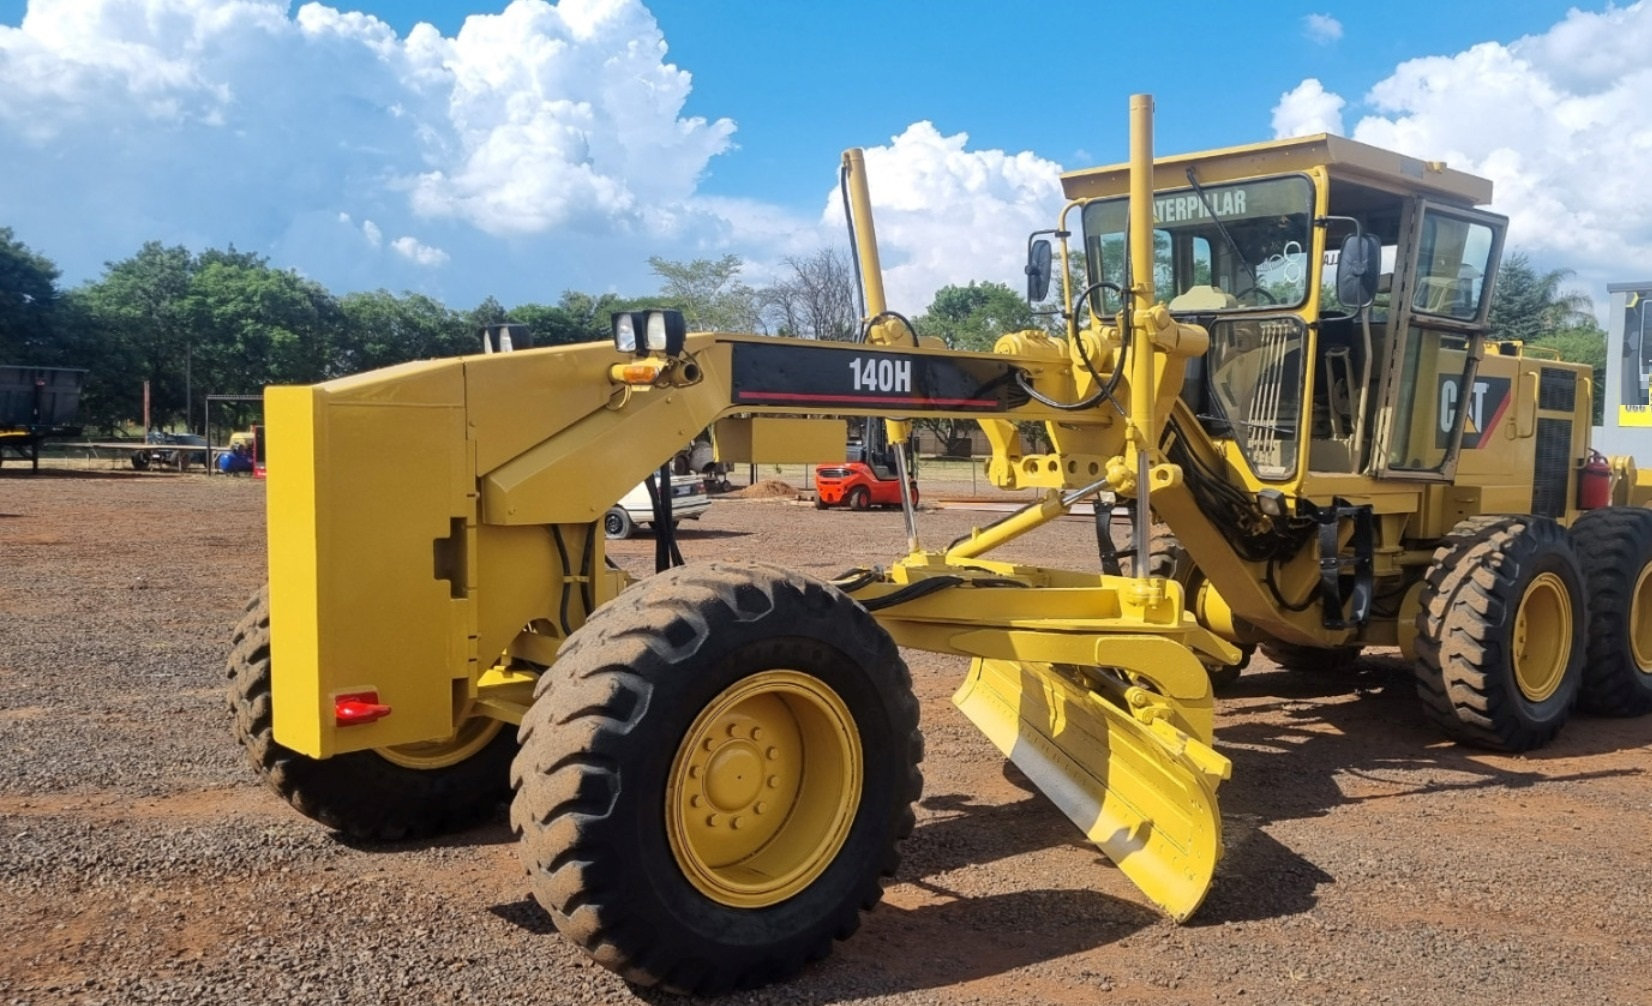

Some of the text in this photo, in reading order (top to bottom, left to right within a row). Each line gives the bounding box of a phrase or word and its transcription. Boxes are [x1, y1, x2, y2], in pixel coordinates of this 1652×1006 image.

[1152, 190, 1246, 223] TERPILLAR
[850, 357, 911, 392] 140H
[1440, 380, 1489, 433] CT
